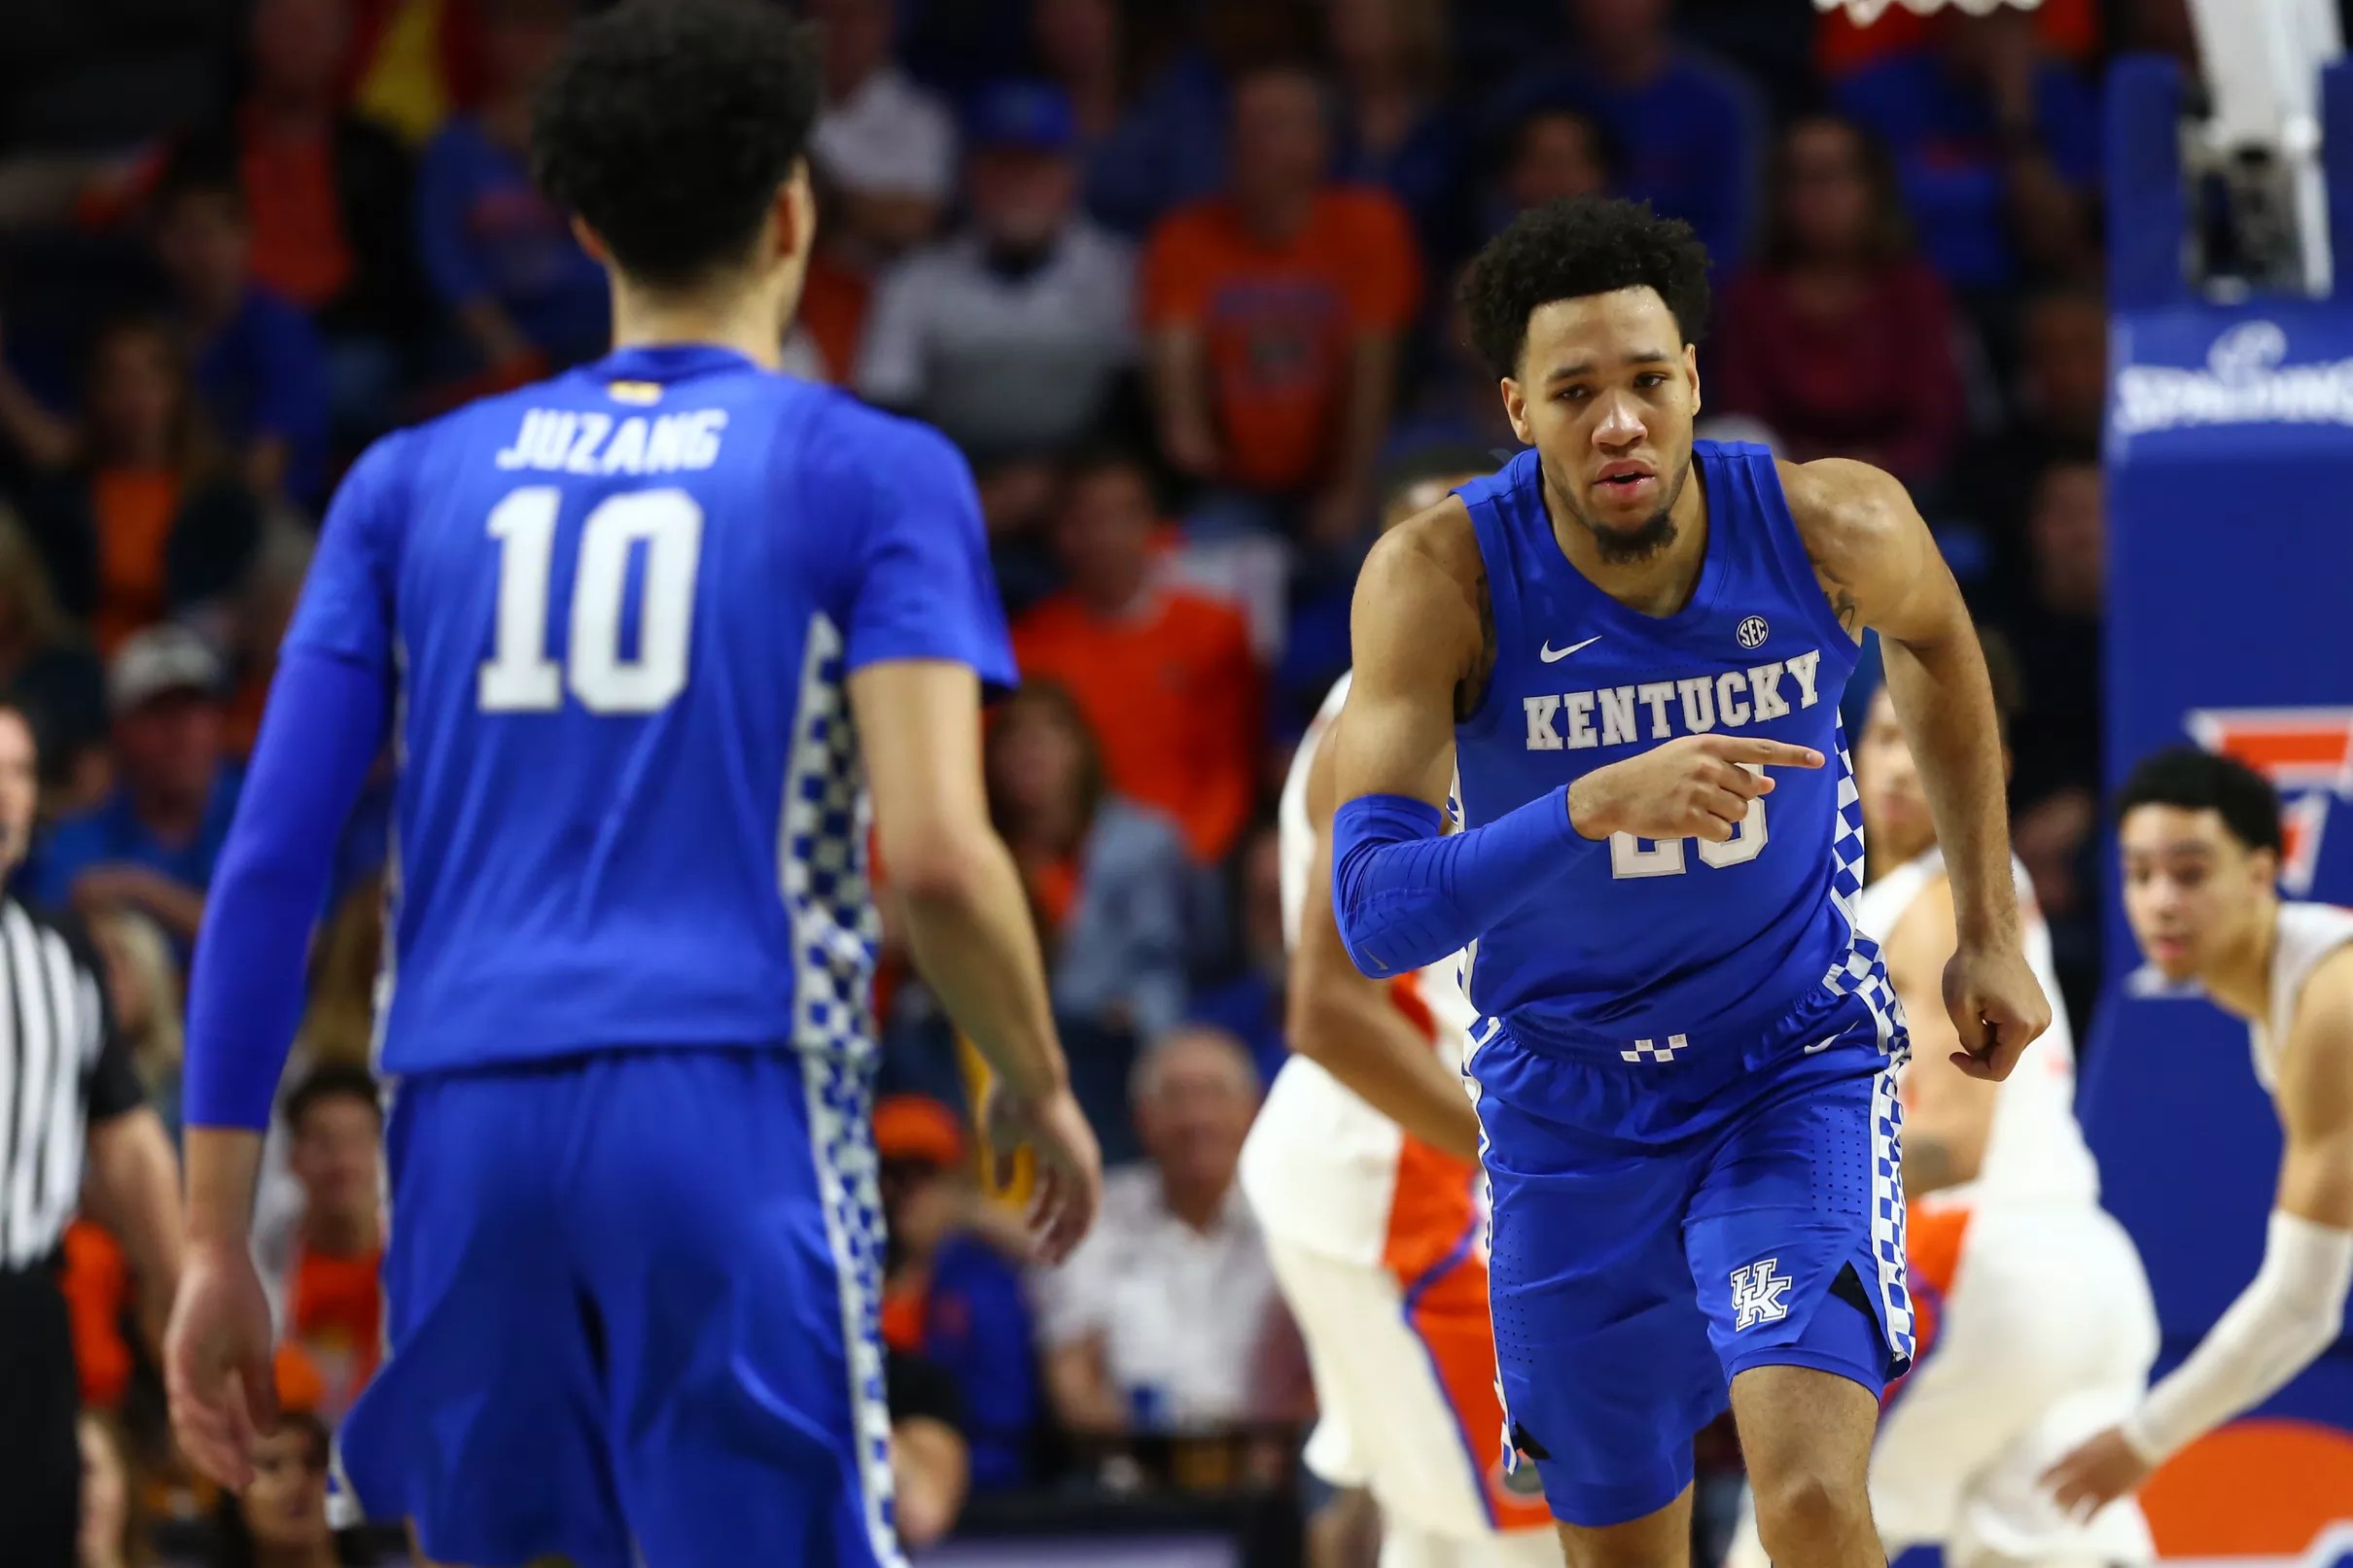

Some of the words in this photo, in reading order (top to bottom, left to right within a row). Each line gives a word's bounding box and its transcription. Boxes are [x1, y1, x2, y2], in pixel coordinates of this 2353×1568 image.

[495, 407, 729, 475] JUZANG
[476, 486, 706, 715] 10
[1739, 618, 1766, 646] SEC
[1524, 649, 1820, 750] KENTUCKY
